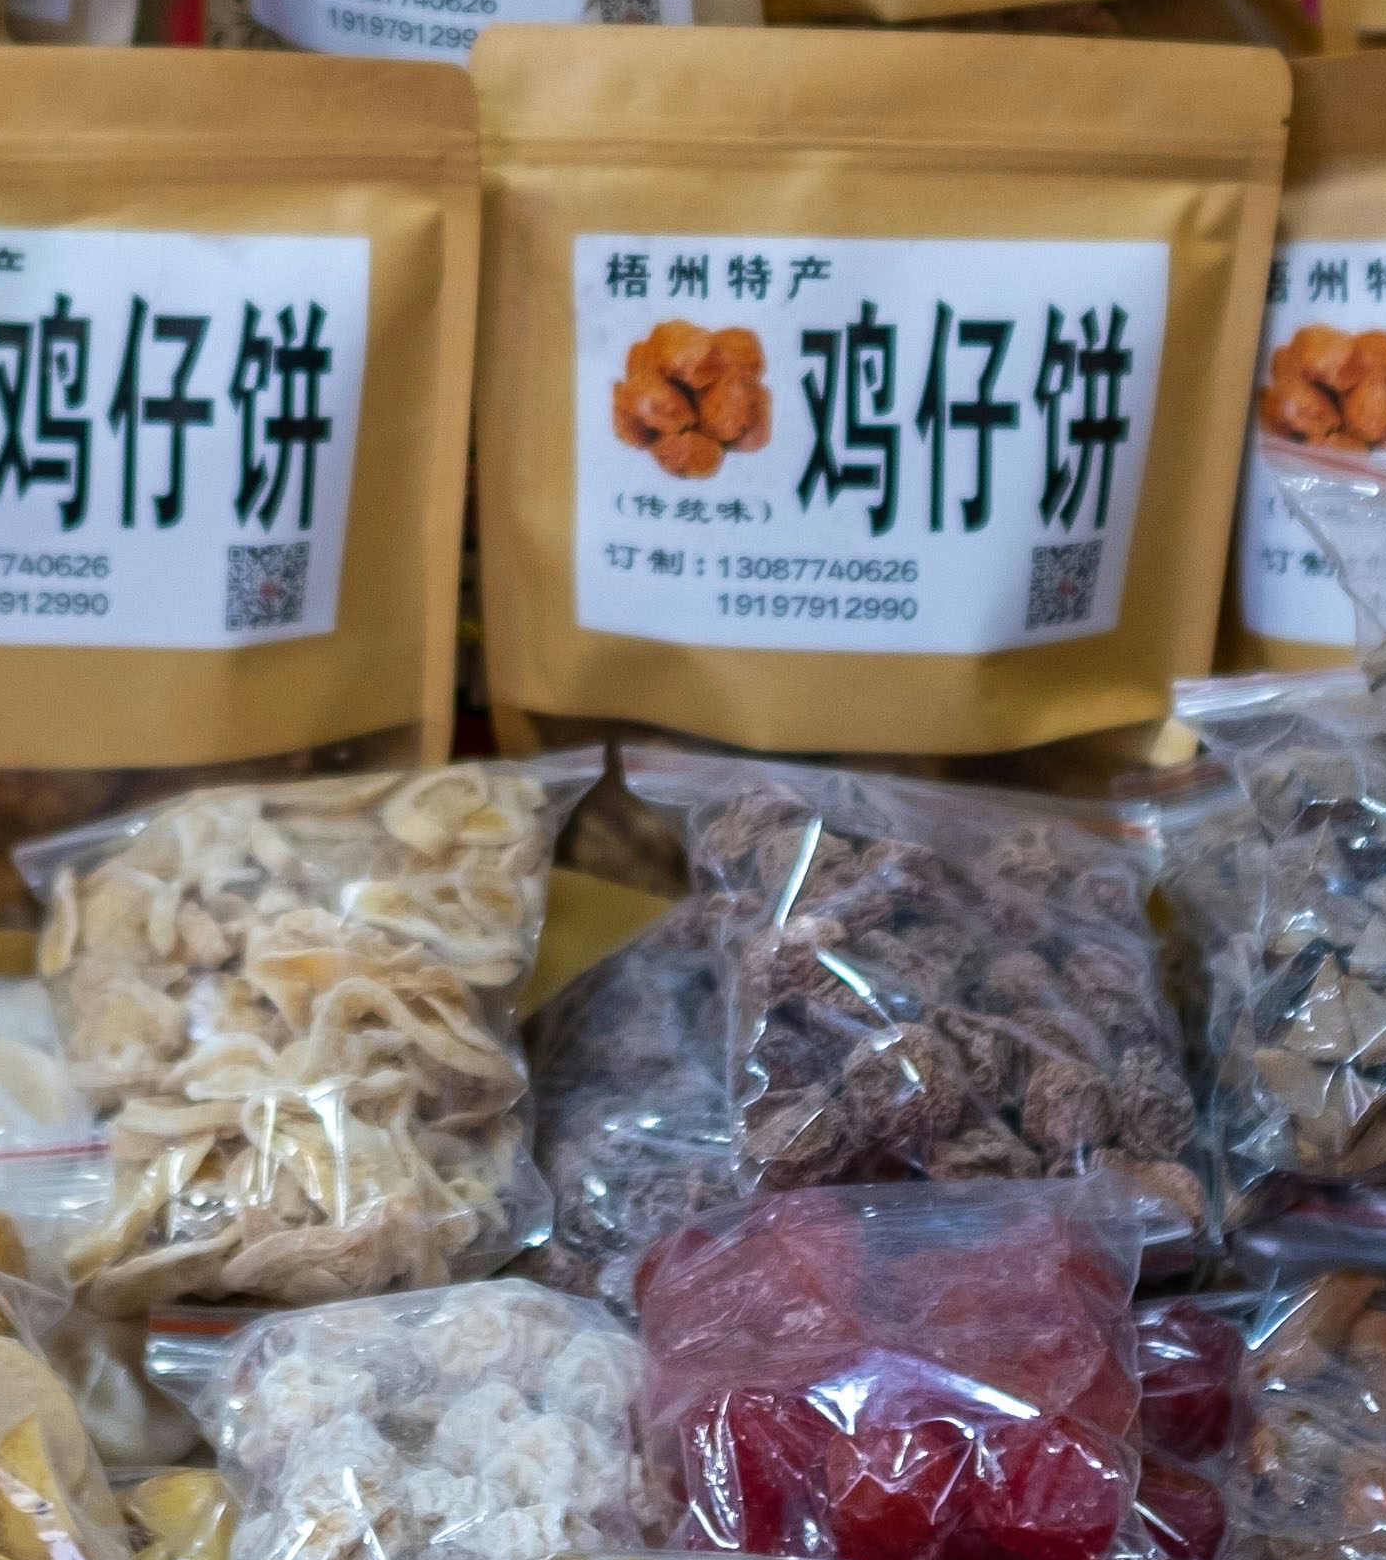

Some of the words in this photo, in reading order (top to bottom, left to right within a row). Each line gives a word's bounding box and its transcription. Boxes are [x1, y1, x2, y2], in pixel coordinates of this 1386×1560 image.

[328, 7, 479, 50] 1919791299
[605, 251, 832, 302] 梧州特产
[794, 298, 1134, 539] 鸡仔饼
[716, 592, 919, 621] 19197912990
